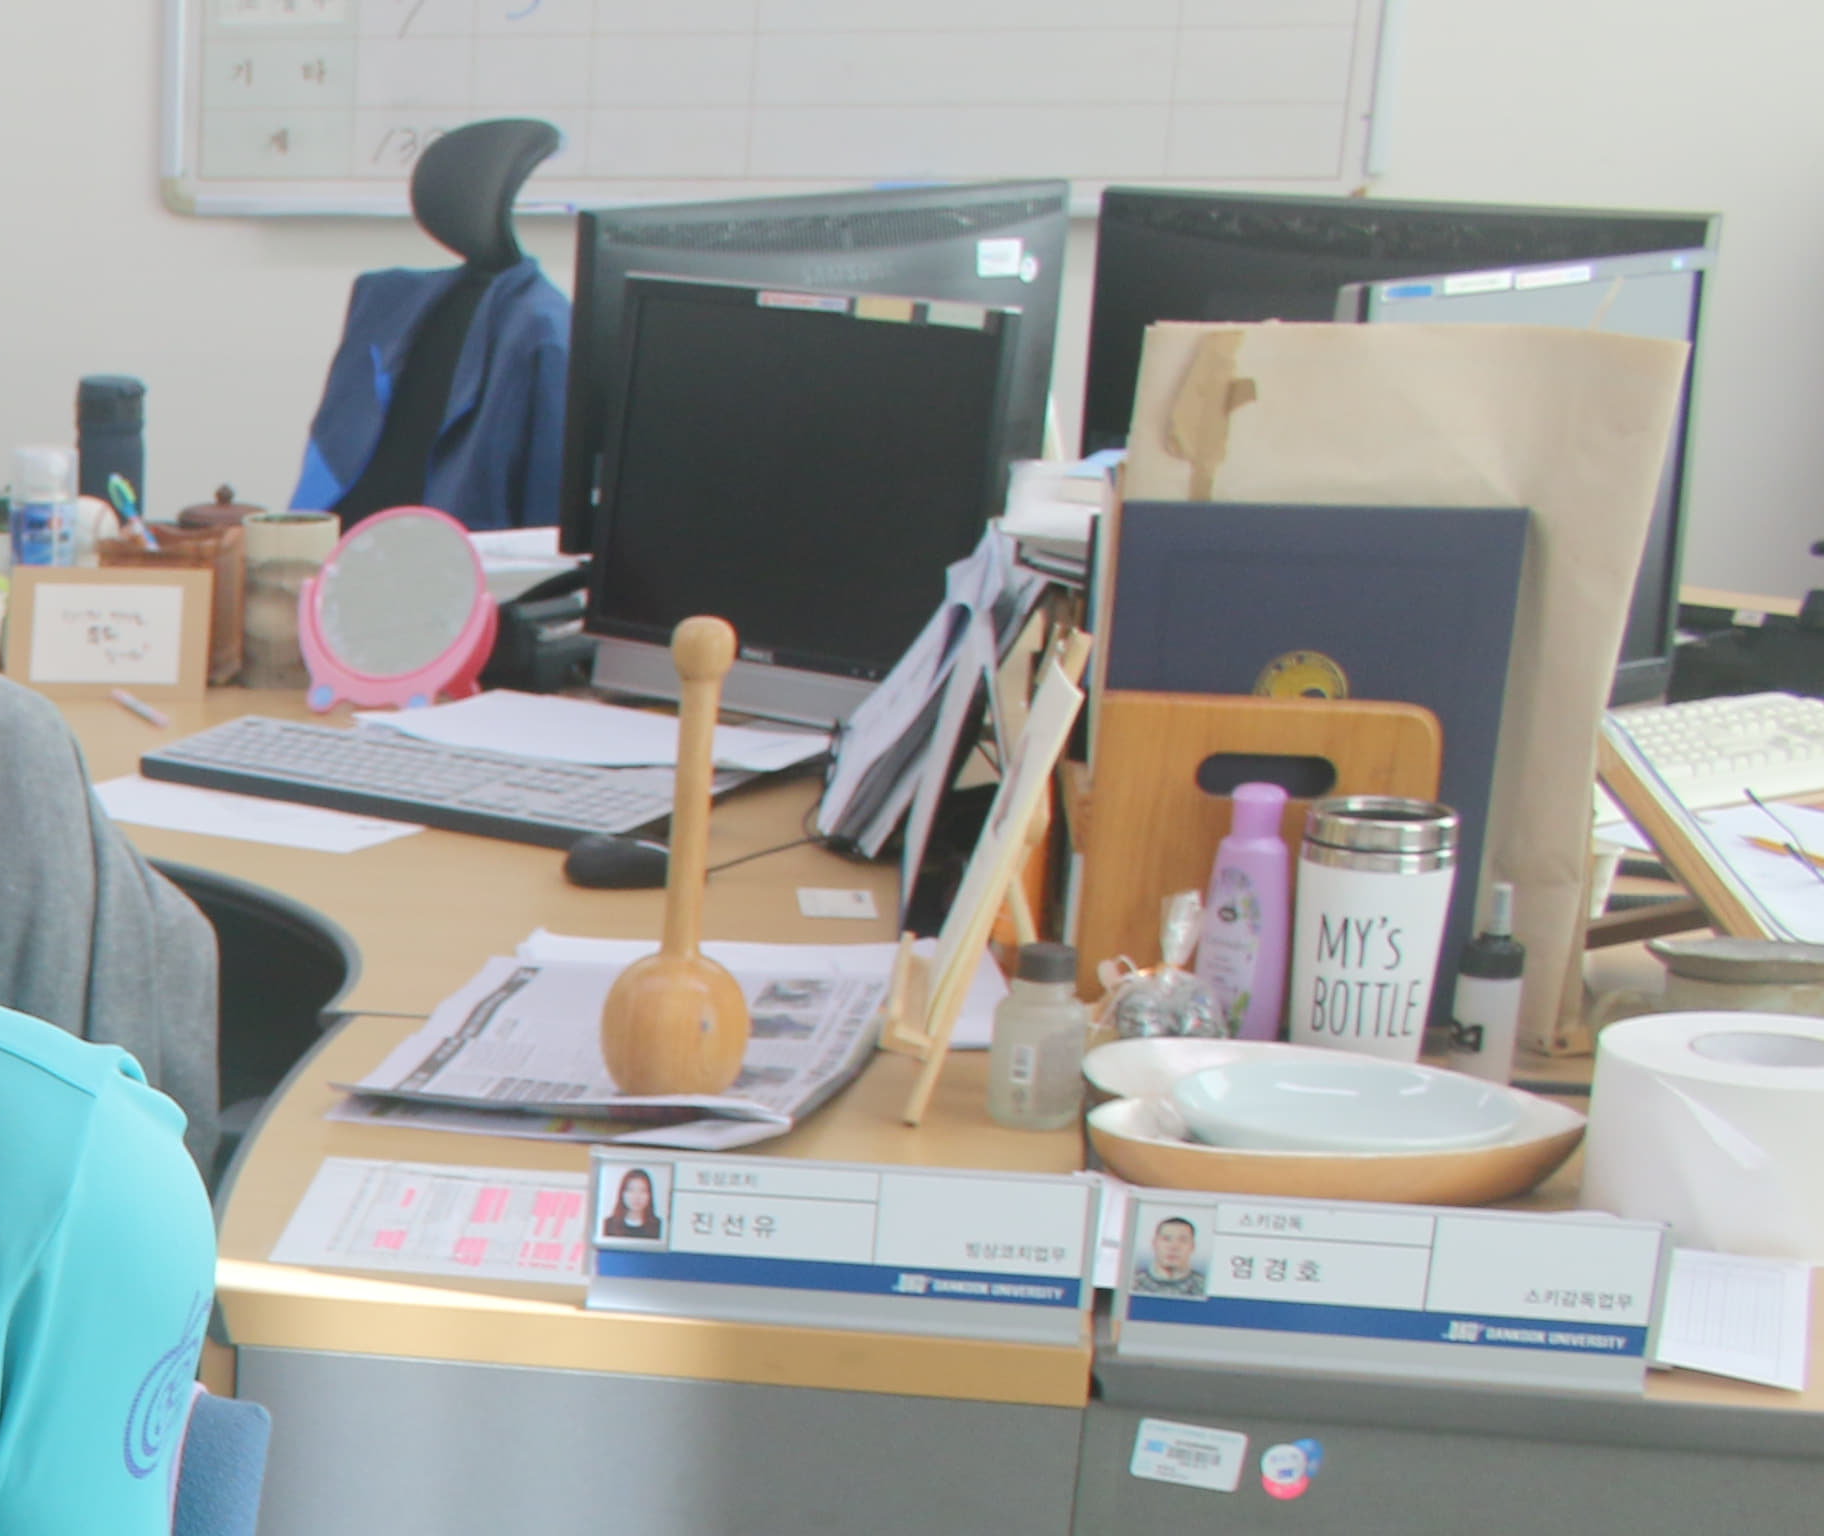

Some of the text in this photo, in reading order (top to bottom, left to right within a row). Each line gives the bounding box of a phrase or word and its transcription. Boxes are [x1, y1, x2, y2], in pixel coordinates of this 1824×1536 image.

[1310, 977, 1423, 1039] BOTTLE
[990, 1283, 1065, 1300] UNIVERSITY
[1547, 1331, 1627, 1350] UNIVERSITY
